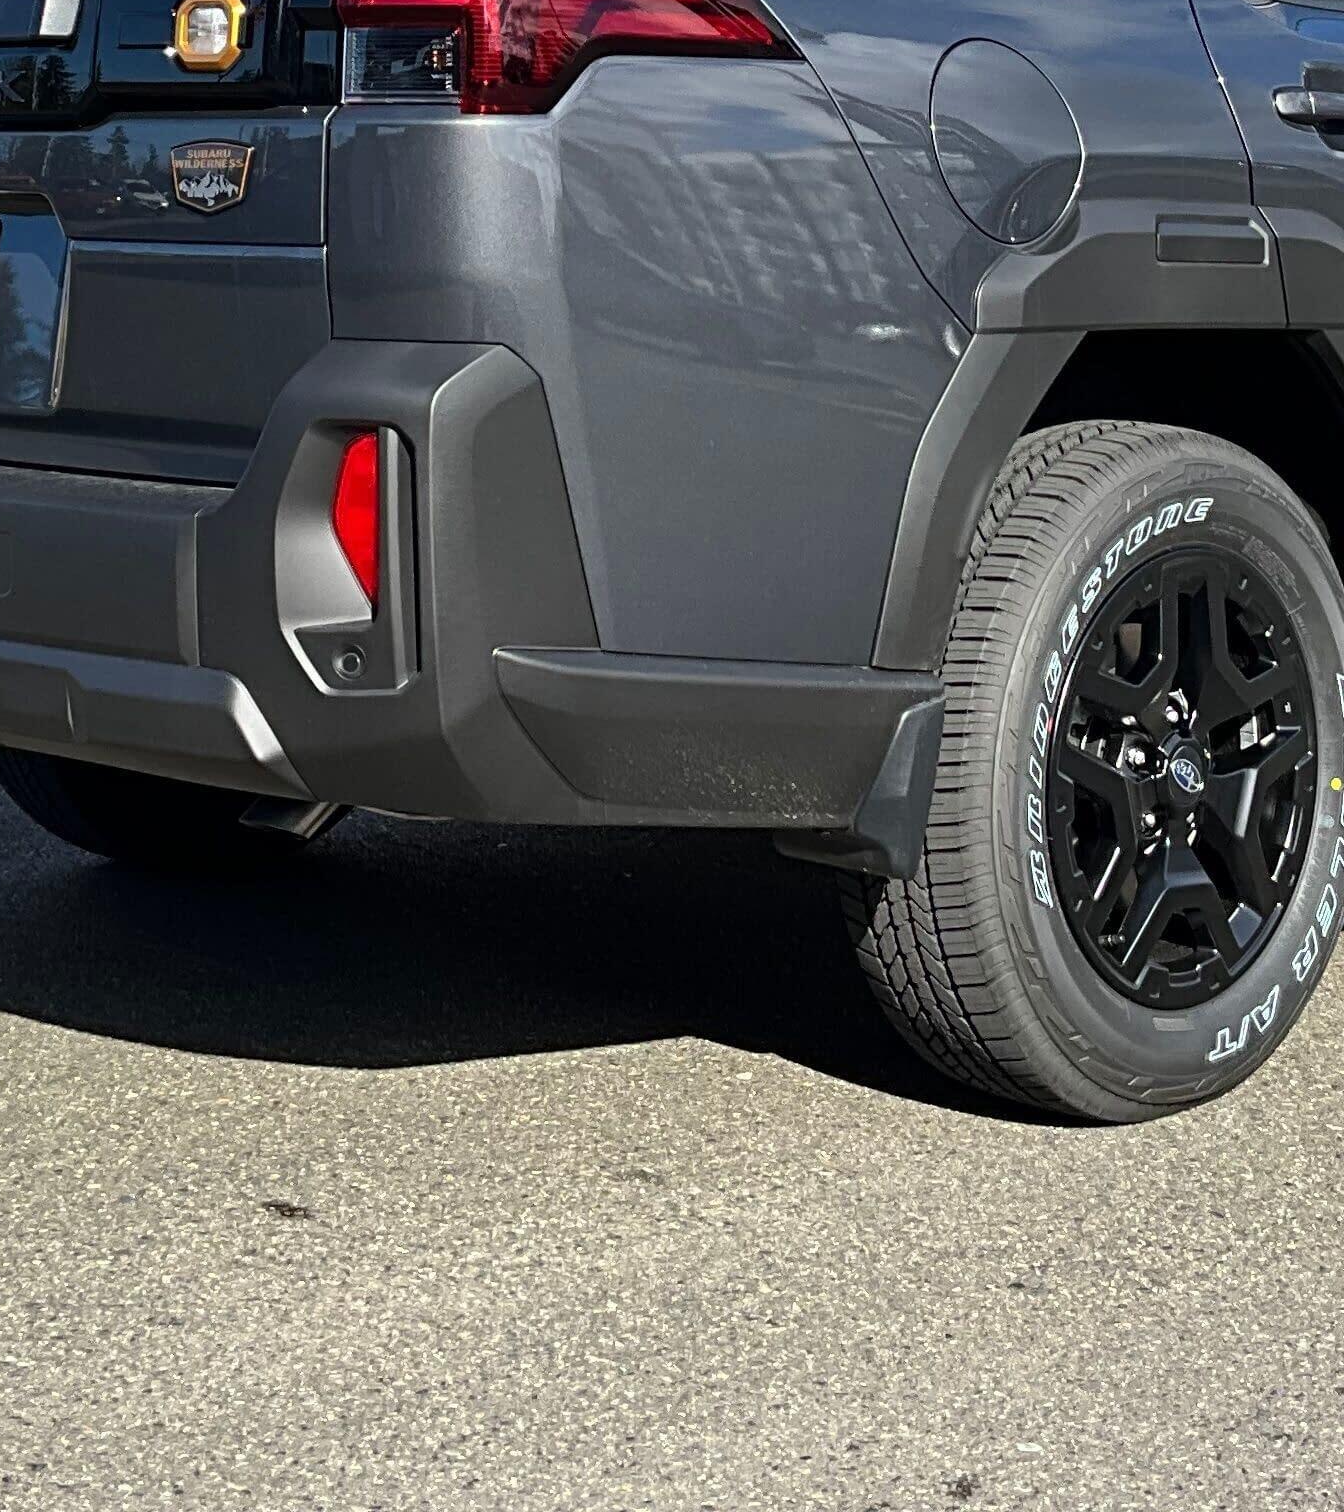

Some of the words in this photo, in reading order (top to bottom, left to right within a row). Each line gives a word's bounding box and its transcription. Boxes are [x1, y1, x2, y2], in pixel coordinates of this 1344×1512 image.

[174, 159, 244, 169] WILDERNESS
[187, 149, 232, 159] SUBARU
[1026, 497, 1215, 909] BRIDGESTONE
[1208, 985, 1280, 1062] A/T
